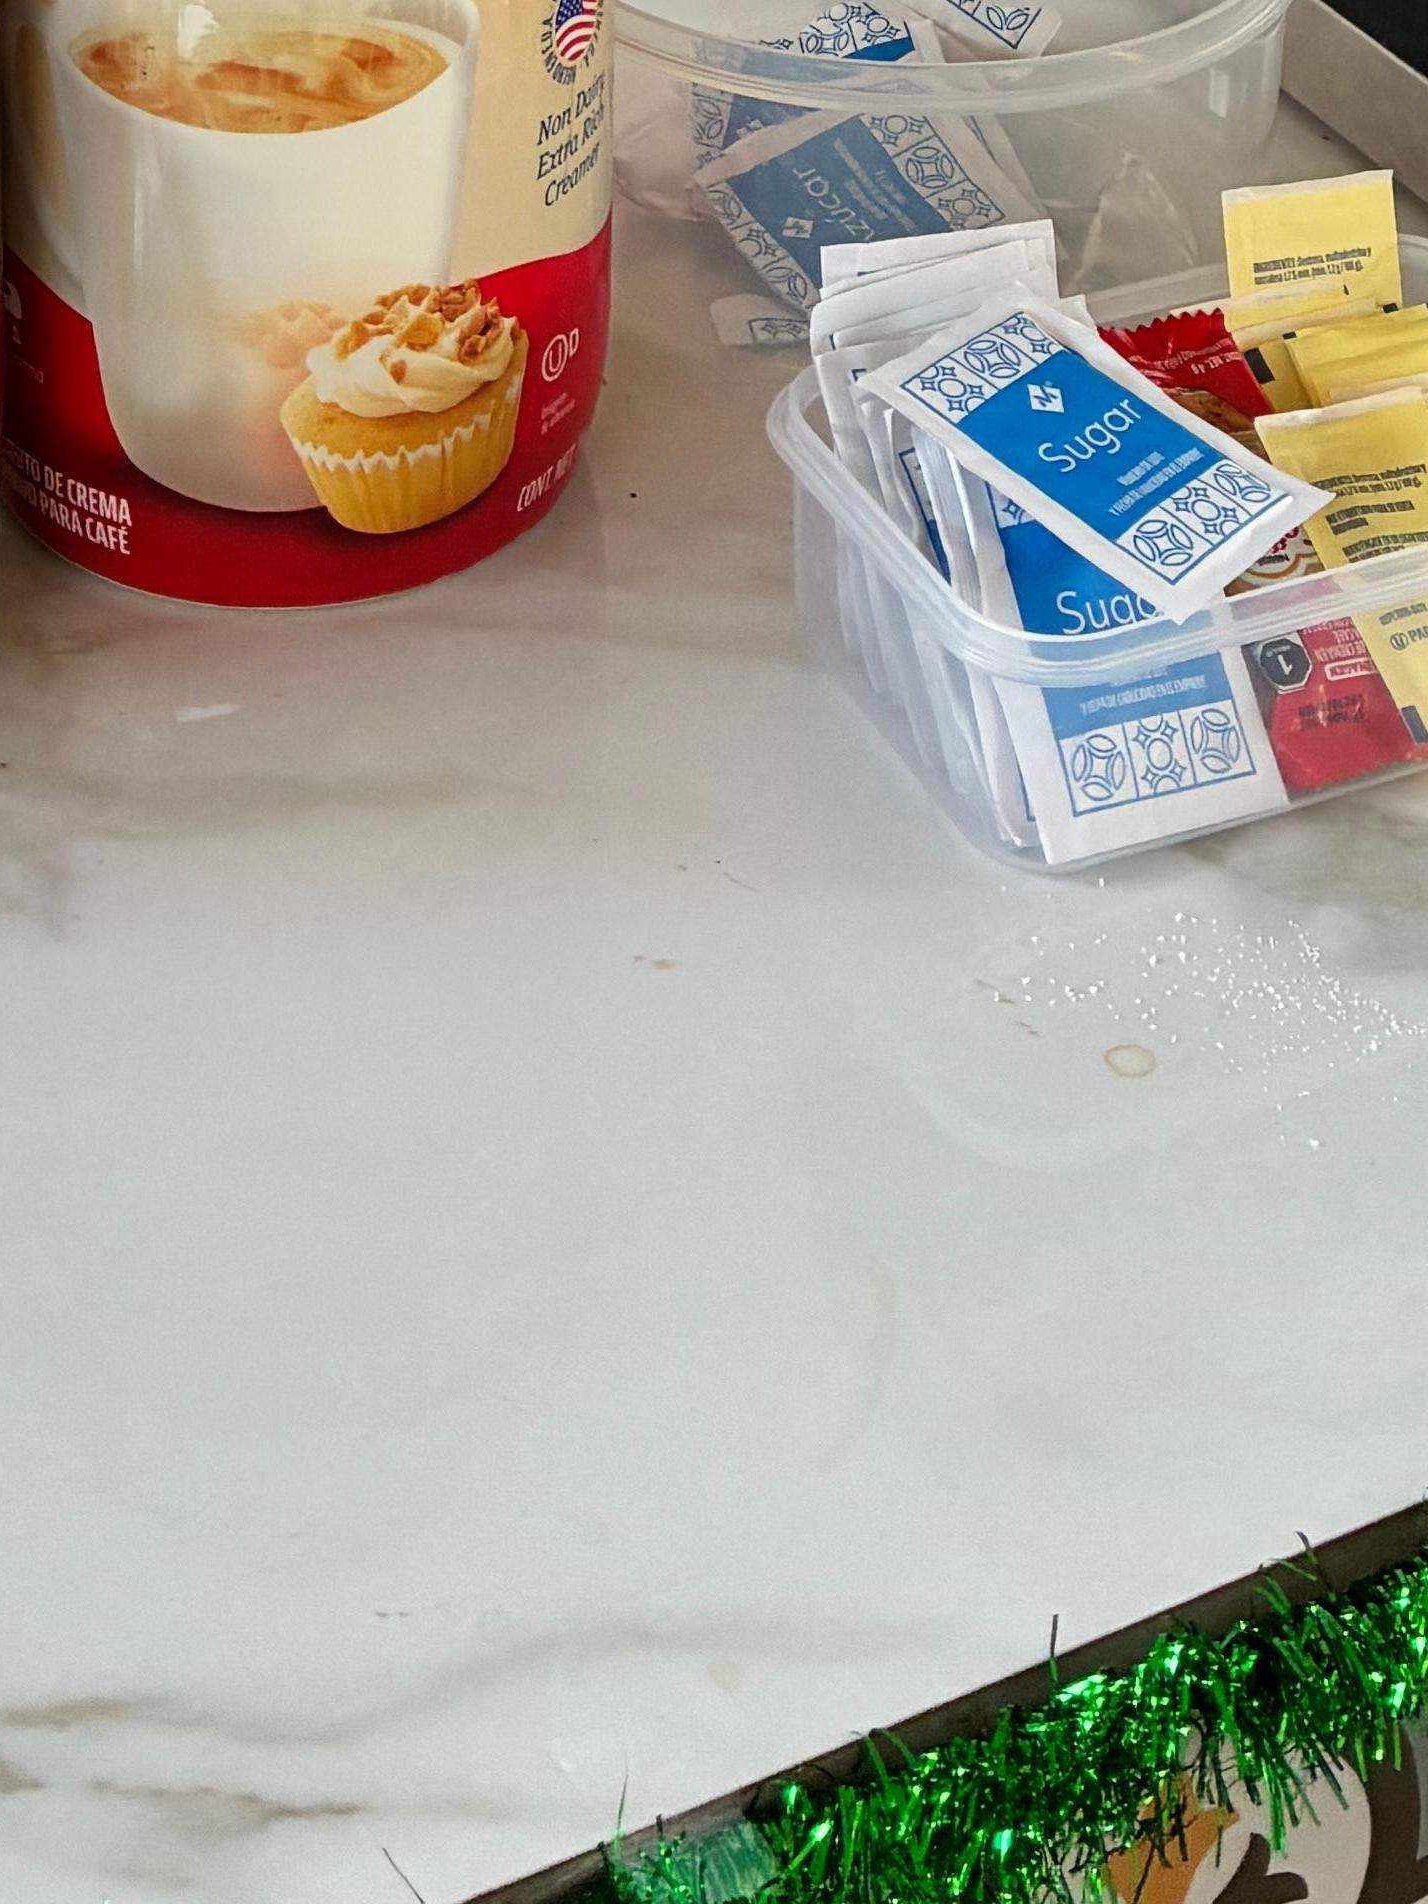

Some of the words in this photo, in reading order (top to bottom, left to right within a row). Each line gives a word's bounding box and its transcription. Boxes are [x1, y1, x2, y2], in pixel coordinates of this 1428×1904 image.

[536, 132, 579, 180] Extra
[581, 103, 606, 141] Rich
[537, 111, 572, 147] Non
[574, 72, 606, 120] Dairy
[544, 141, 601, 207] Creamer
[1038, 398, 1141, 473] Sugar
[39, 491, 84, 538] PARA
[85, 524, 131, 555] CAFÉ
[44, 465, 65, 497] DE
[66, 478, 133, 527] CREMA
